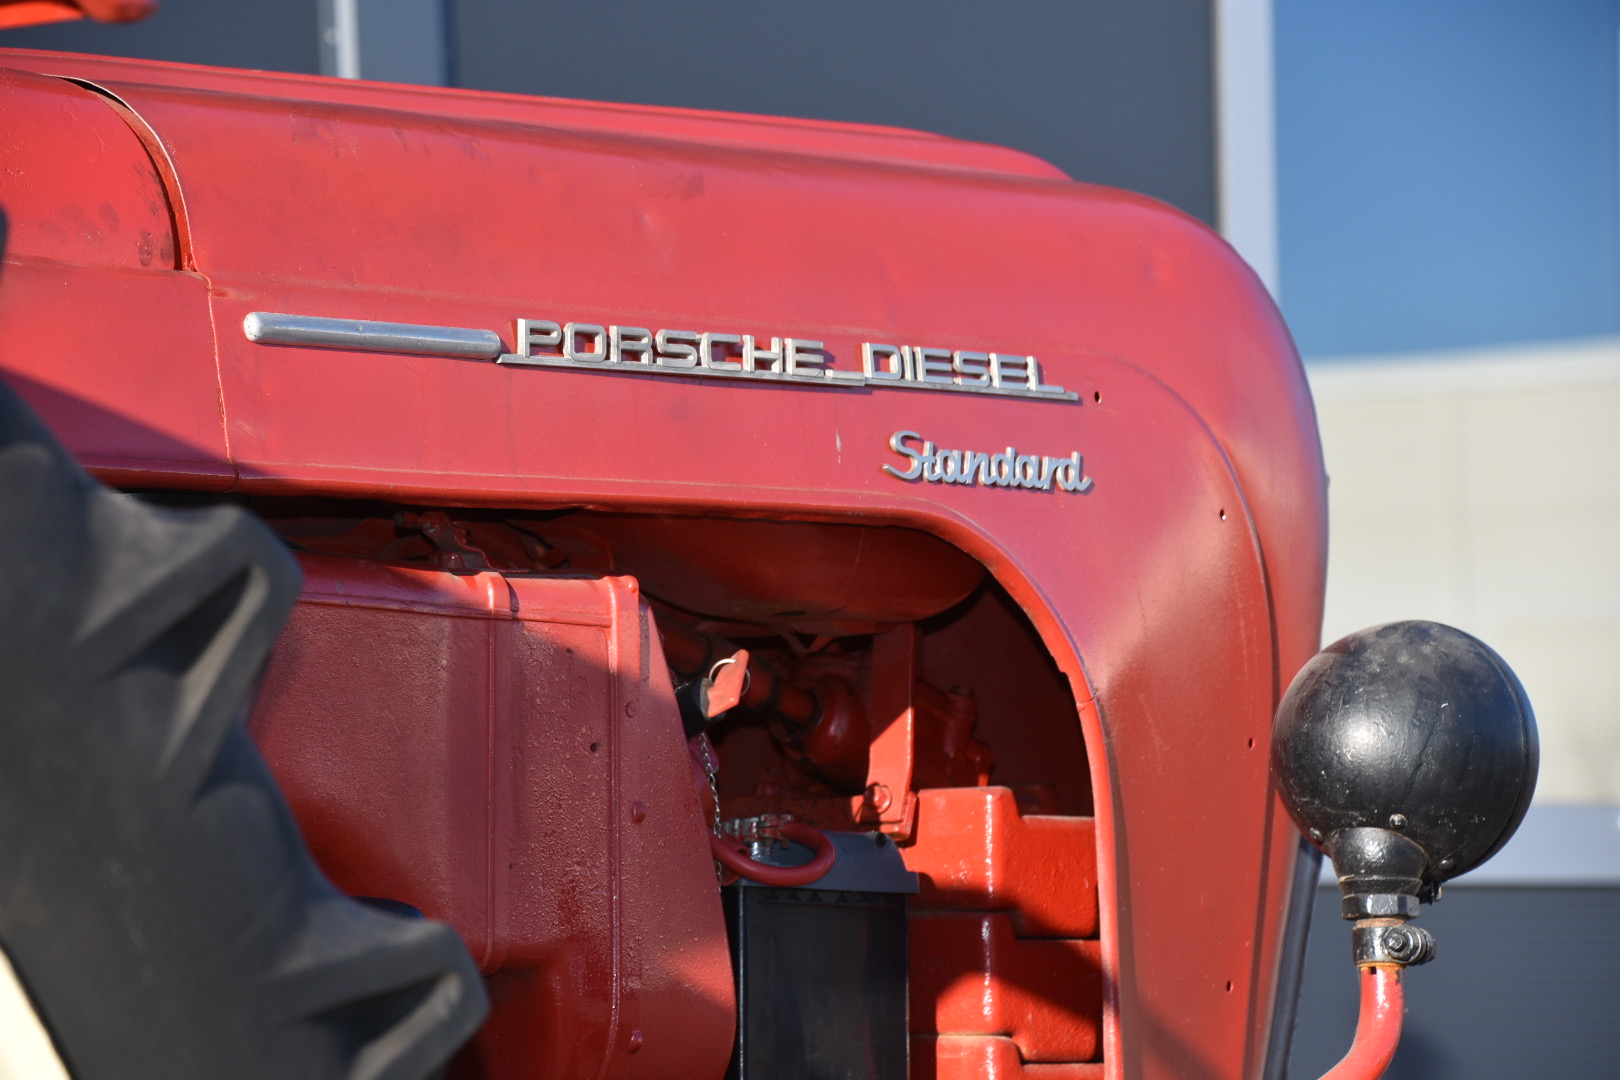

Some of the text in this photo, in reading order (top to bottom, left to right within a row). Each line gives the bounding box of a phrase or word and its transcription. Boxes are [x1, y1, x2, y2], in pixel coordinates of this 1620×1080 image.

[517, 318, 1065, 395] PORSCHE DIESEL
[882, 430, 1092, 492] Standard
